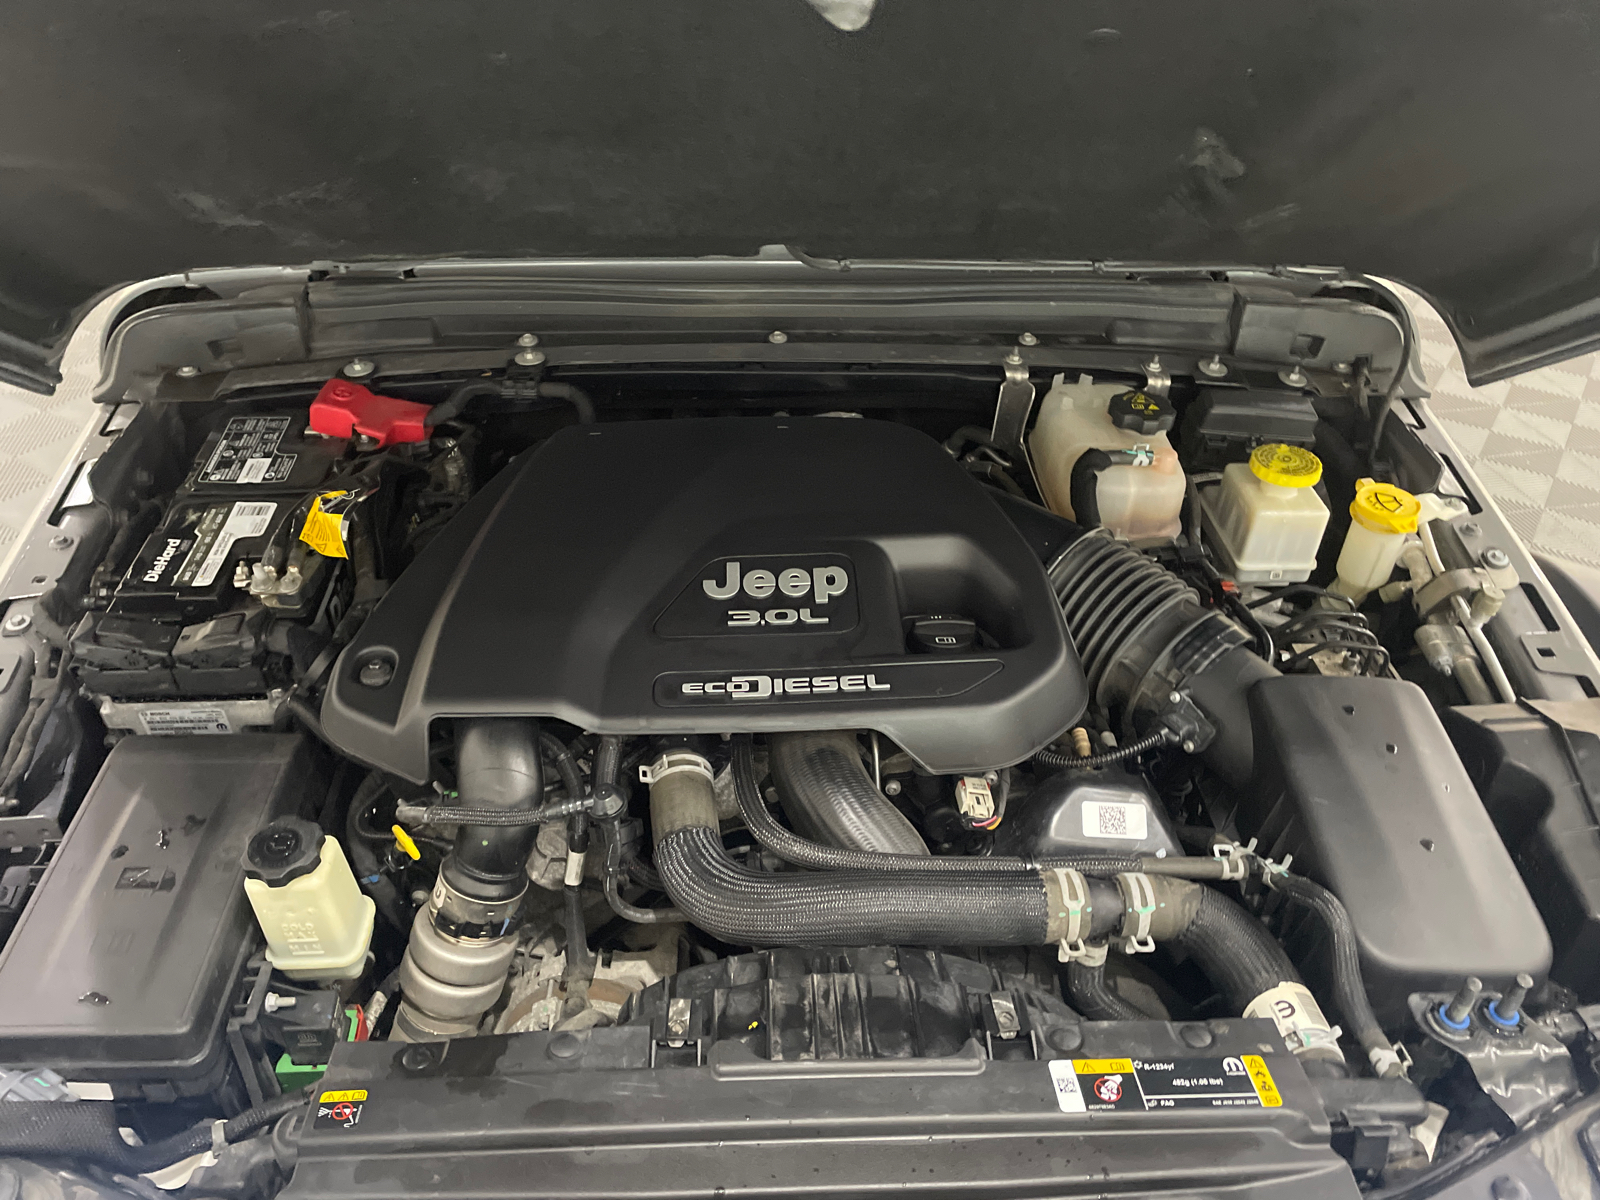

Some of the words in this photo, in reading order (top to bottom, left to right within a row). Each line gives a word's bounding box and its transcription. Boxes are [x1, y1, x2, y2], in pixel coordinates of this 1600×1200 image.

[142, 538, 182, 583] DieHard
[702, 561, 849, 604] Jeep
[727, 608, 830, 626] 3.0L
